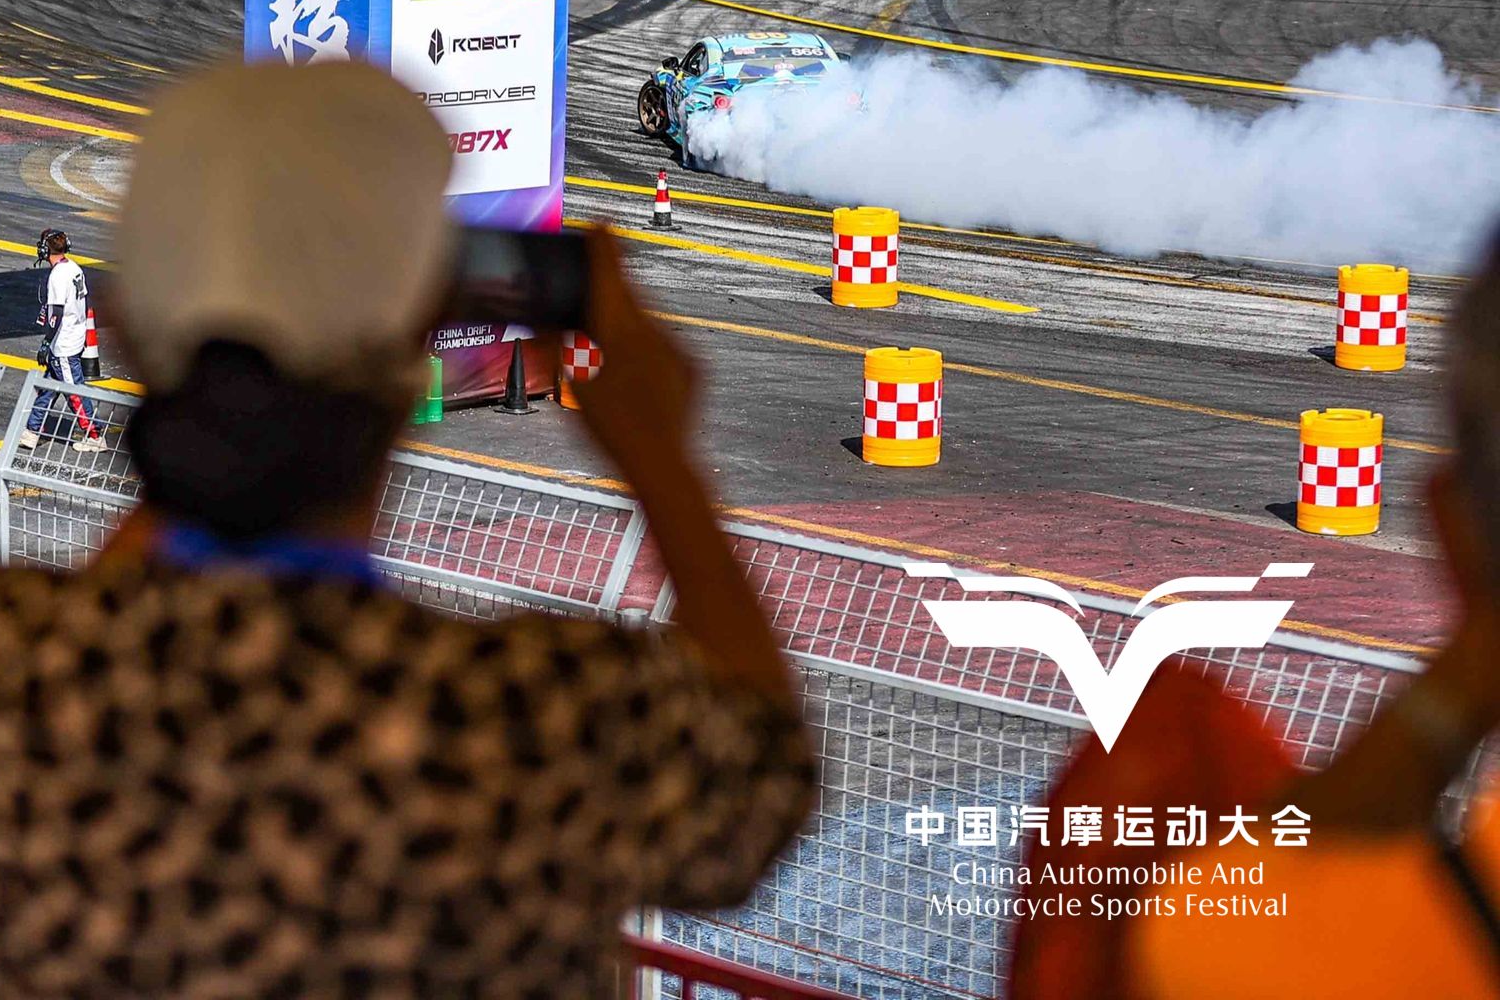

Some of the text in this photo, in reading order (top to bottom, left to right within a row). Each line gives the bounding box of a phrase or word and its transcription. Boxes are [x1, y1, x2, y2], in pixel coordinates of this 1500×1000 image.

[790, 48, 824, 56] 866
[438, 325, 492, 339] CHINA DRIFT
[435, 335, 496, 350] CHAMPIONSHIP
